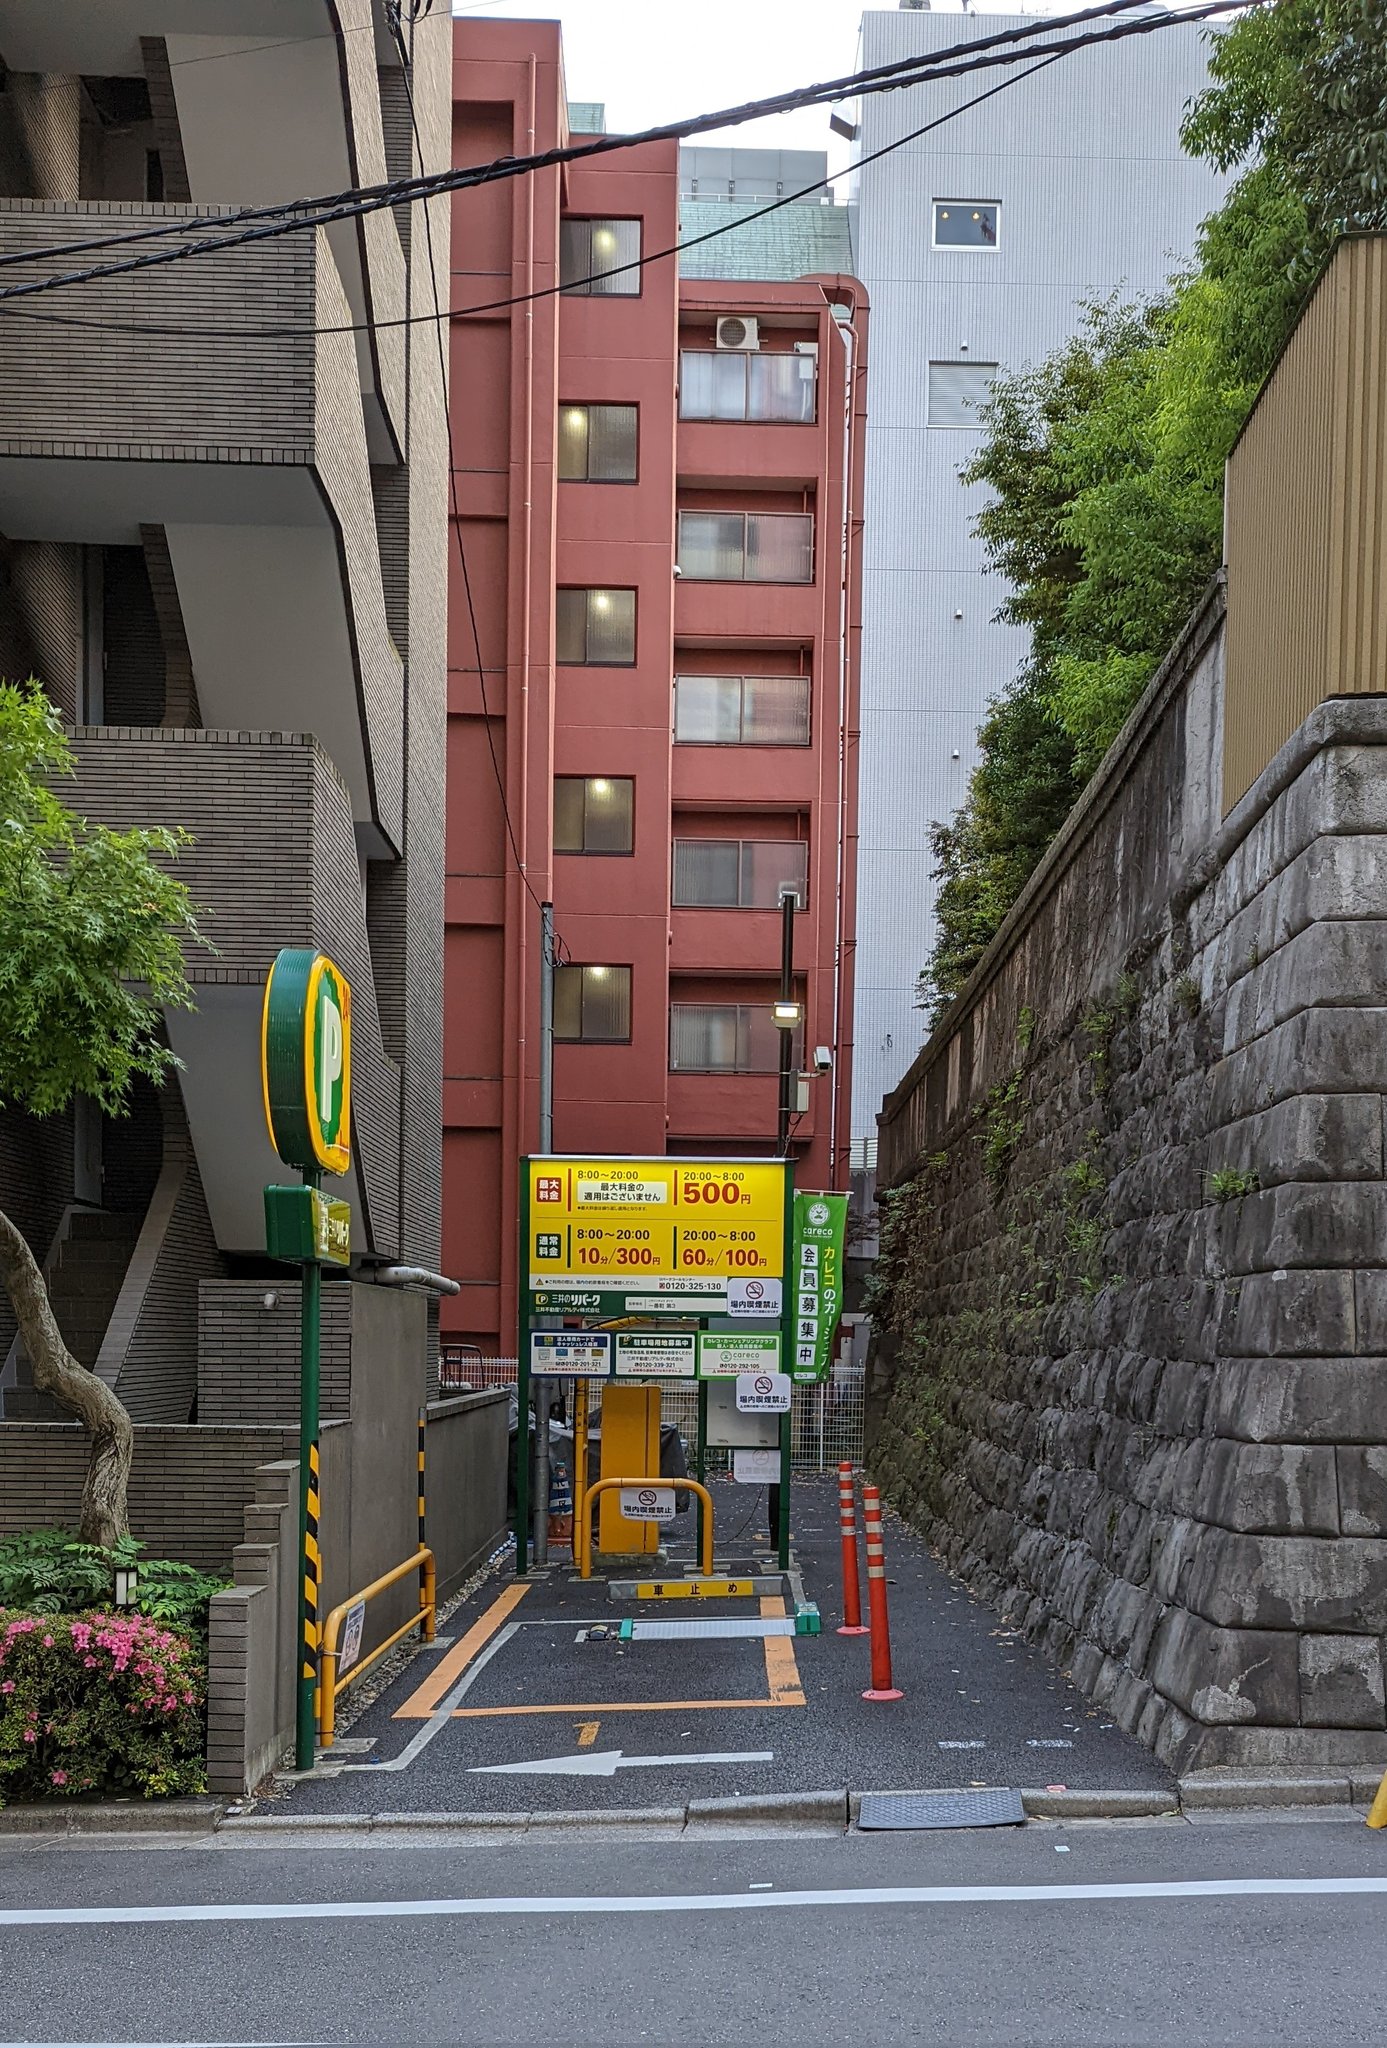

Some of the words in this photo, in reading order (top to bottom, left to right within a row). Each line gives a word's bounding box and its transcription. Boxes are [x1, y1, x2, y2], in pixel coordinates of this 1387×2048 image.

[320, 996, 342, 1123] P
[539, 1180, 560, 1189] 最大
[601, 1183, 645, 1191] 最大料金の
[539, 1190, 560, 1200] 料金
[584, 1192, 661, 1201] 適用はございません
[803, 1227, 833, 1236] careco
[539, 1236, 559, 1245] 通常
[539, 1247, 559, 1256] 料金
[551, 1294, 601, 1306] 三井のリパーク
[730, 1300, 779, 1308] 場内喫煙禁止
[800, 1247, 816, 1362] 会員募集中
[739, 1396, 788, 1404] 場内喫煙禁止
[572, 1721, 601, 1746] 1
